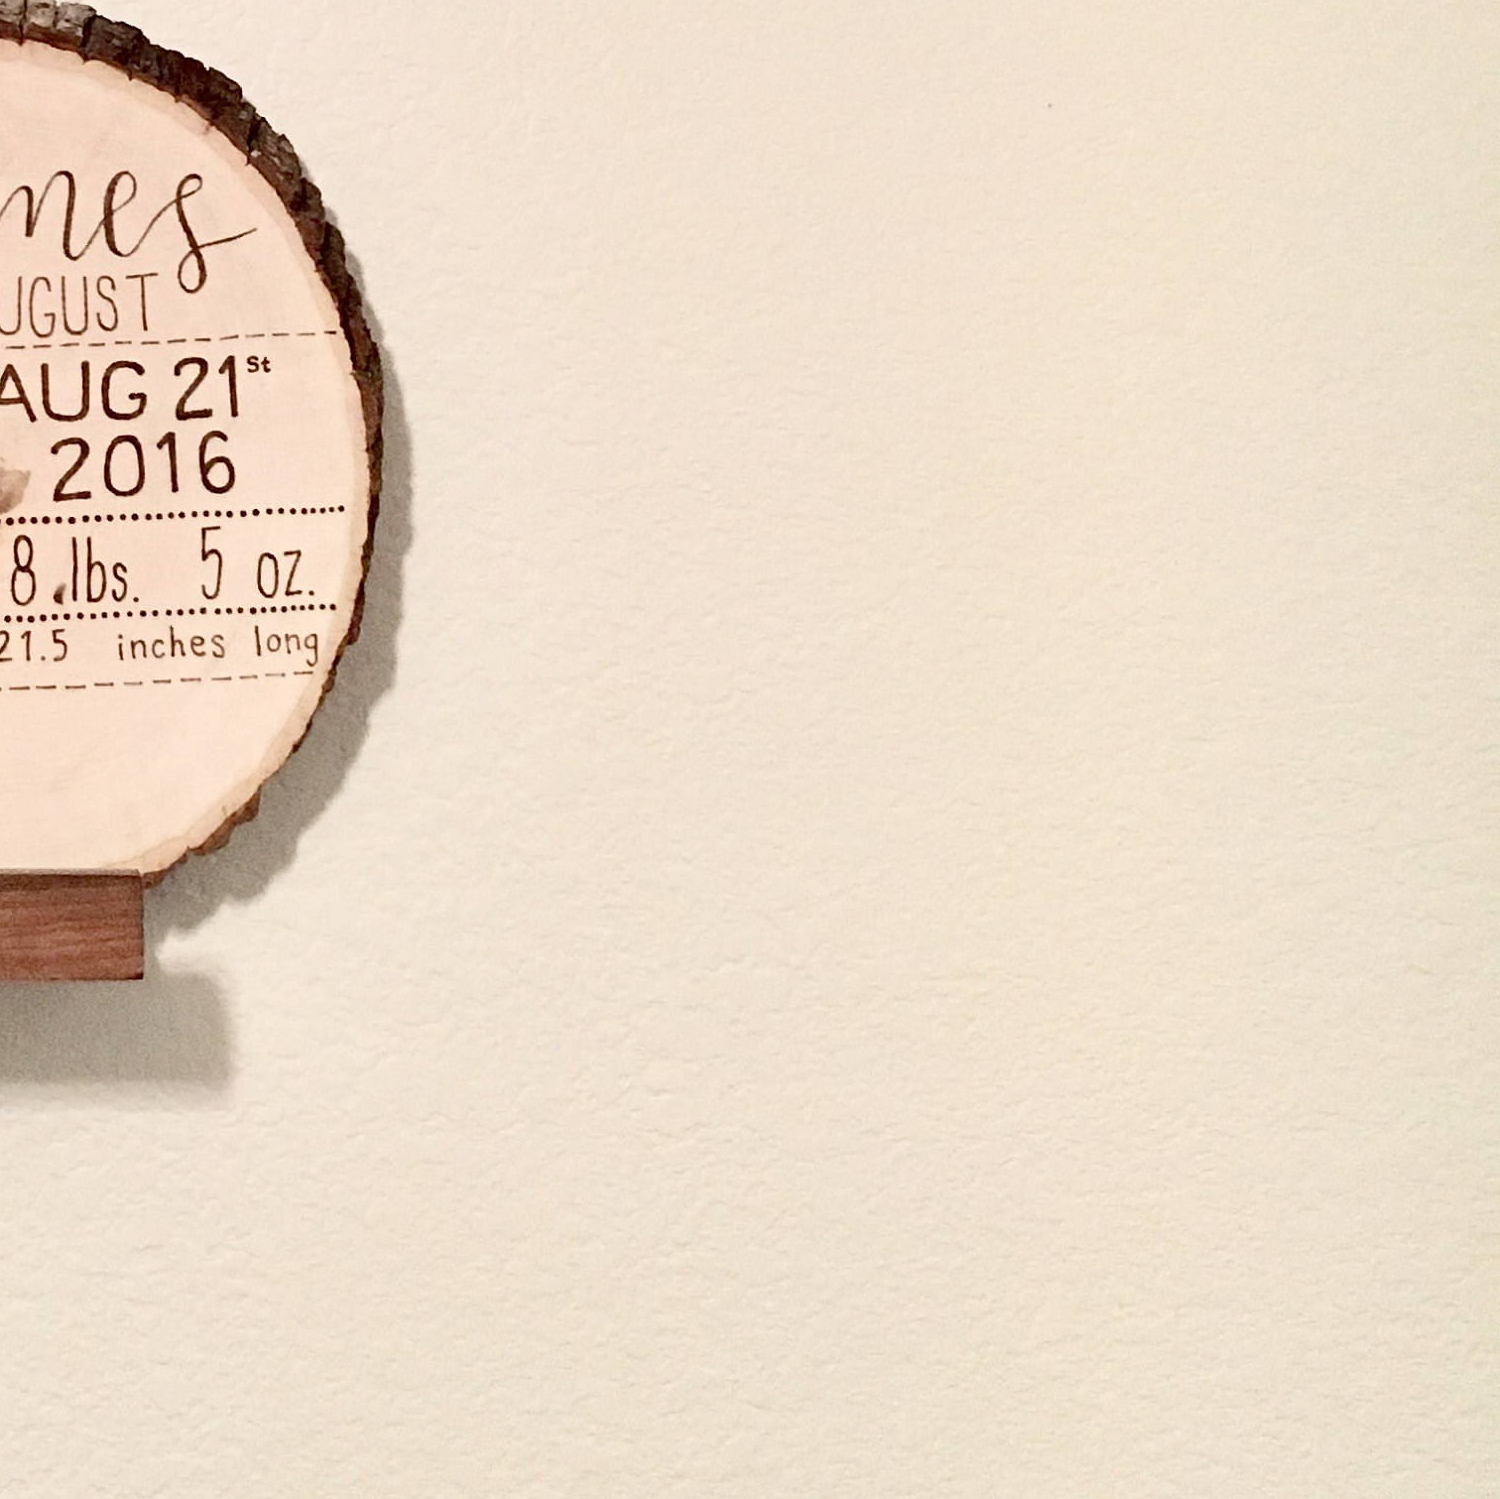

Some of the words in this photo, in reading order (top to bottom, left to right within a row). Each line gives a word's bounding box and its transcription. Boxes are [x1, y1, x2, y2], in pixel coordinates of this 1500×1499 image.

[49, 429, 237, 504] 2016
[9, 534, 37, 607] 8
[71, 535, 140, 604] lbs.
[200, 525, 224, 601] 5
[117, 629, 226, 661] inches
[254, 624, 319, 668] long
